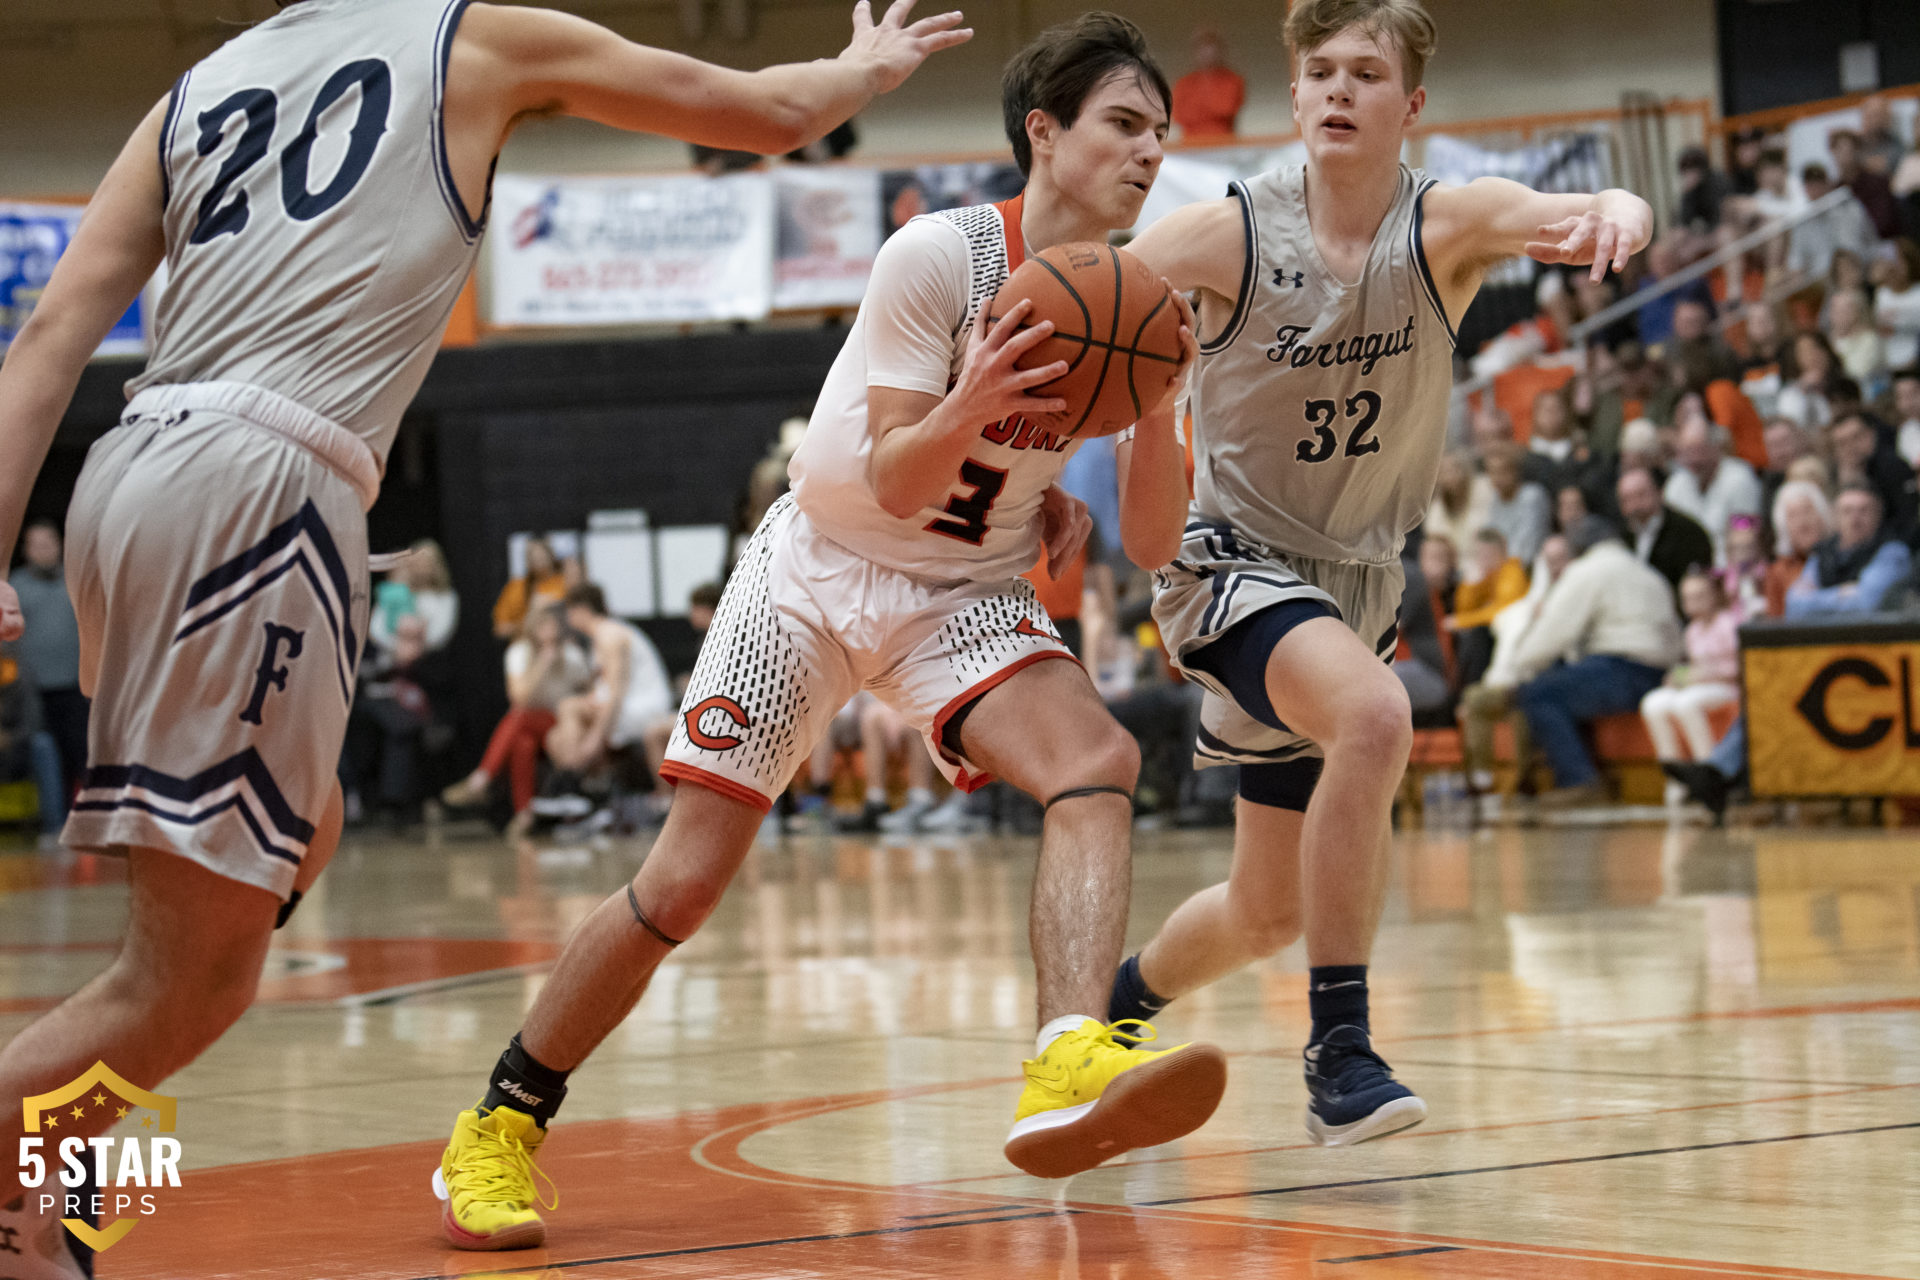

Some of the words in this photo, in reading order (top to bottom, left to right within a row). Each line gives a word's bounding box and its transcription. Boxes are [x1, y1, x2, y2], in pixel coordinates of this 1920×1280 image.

[189, 57, 392, 245] 20
[1266, 315, 1415, 376] Farragut
[1295, 390, 1382, 463] 32
[922, 456, 1010, 547] 3
[238, 621, 306, 726] F
[683, 694, 751, 752] C
